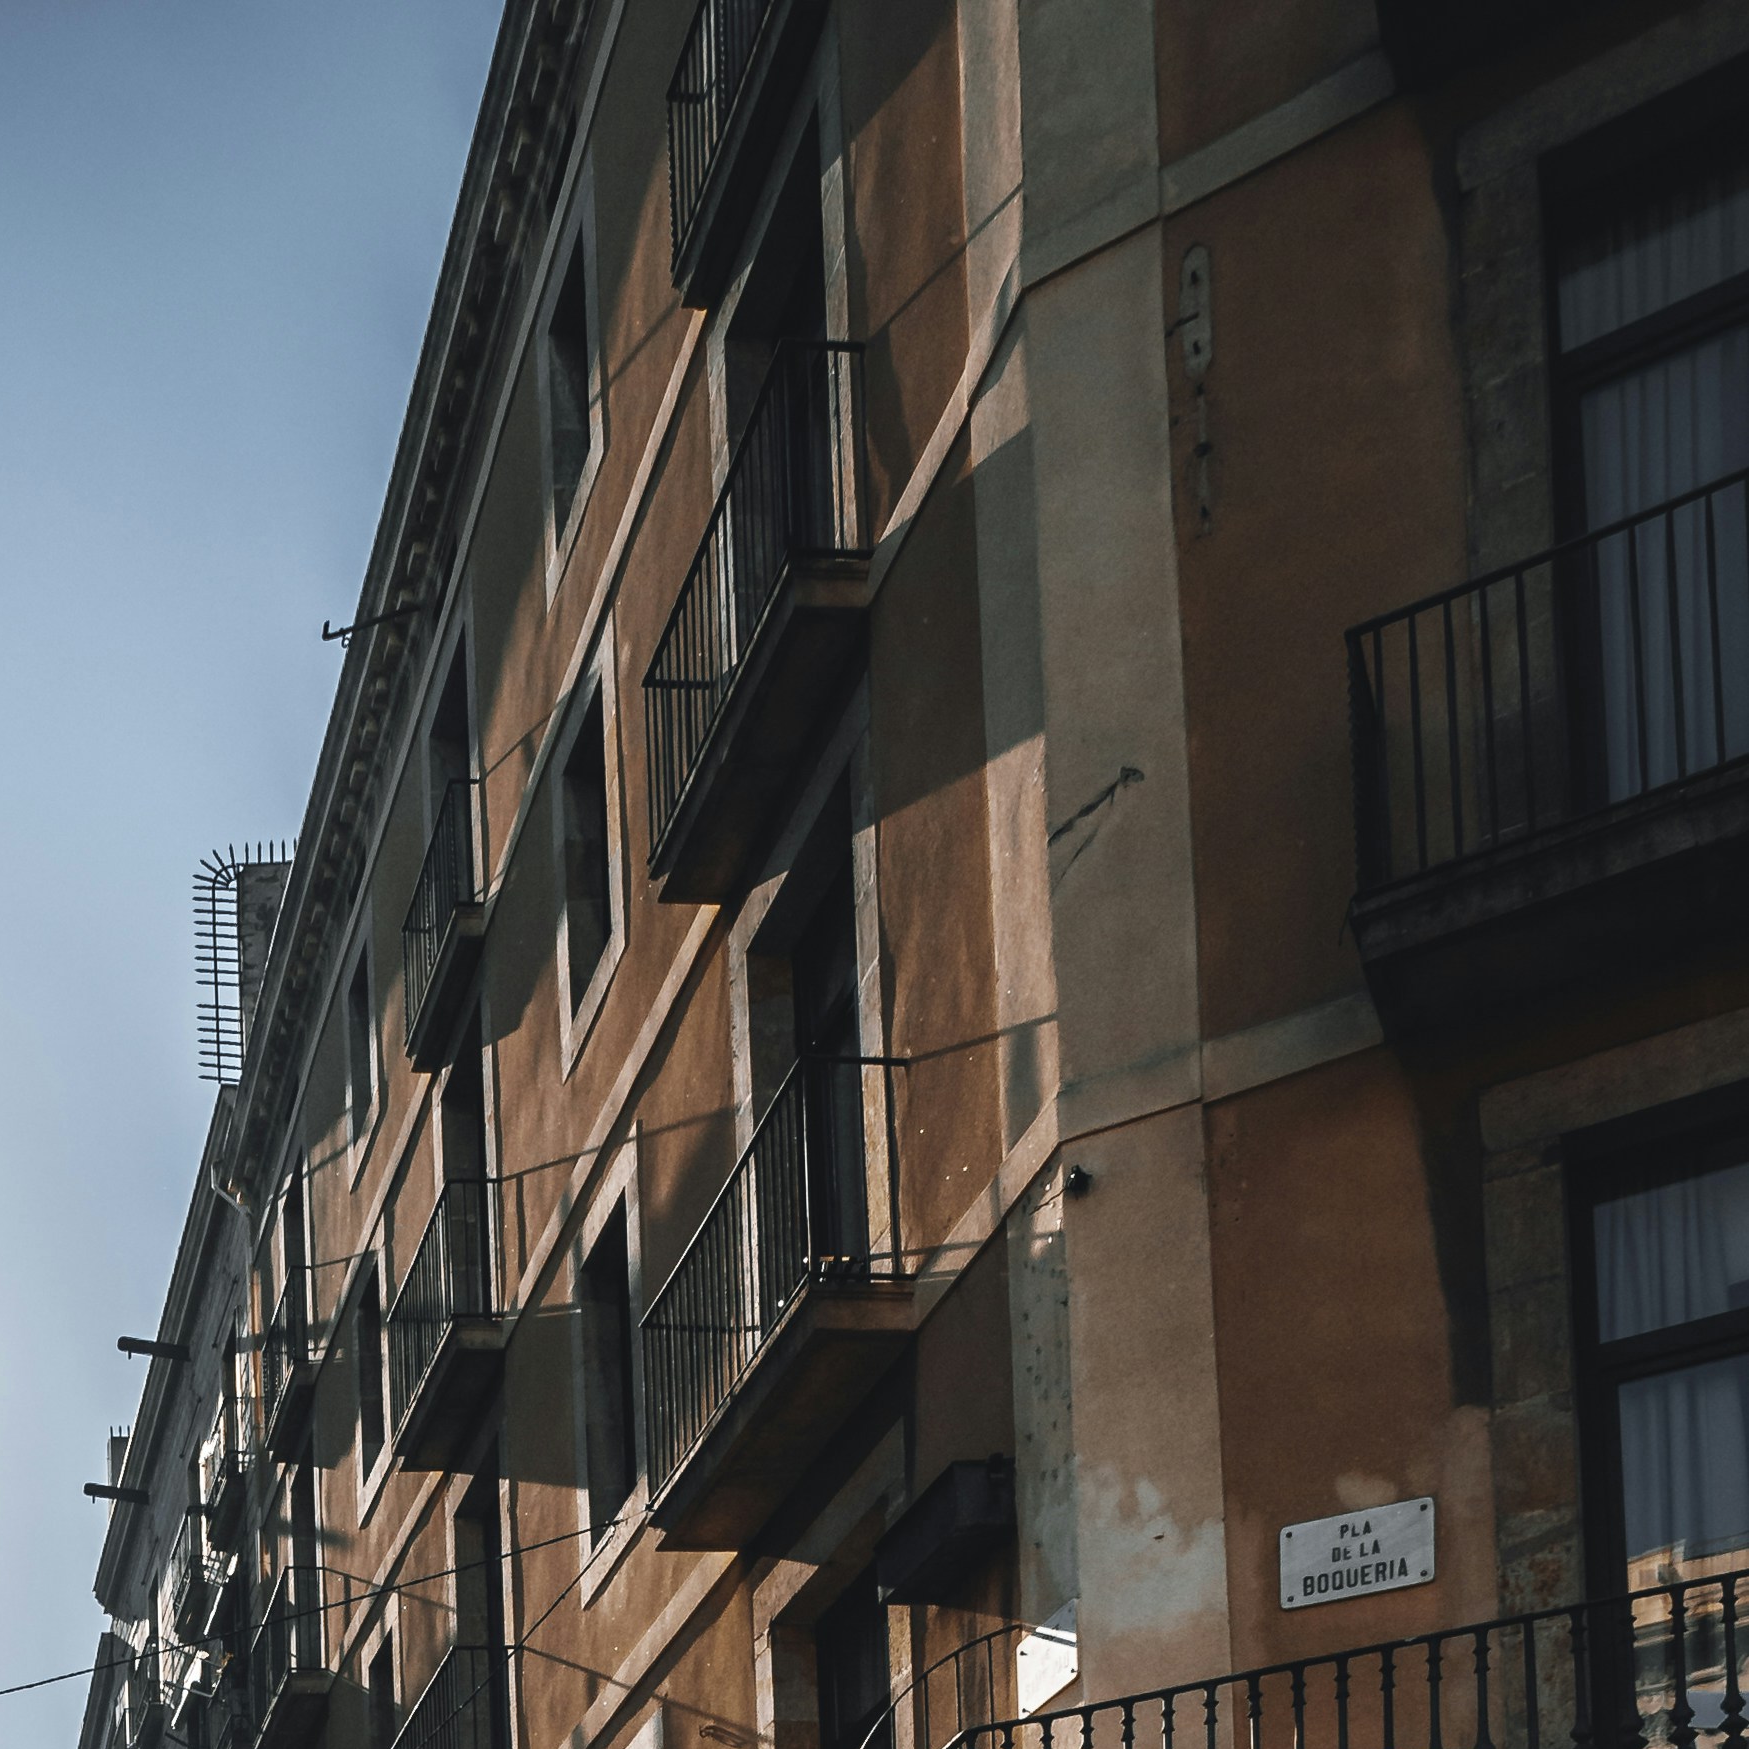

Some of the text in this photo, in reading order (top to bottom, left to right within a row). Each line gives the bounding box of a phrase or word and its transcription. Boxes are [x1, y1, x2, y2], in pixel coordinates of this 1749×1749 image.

[1339, 1520, 1372, 1539] PLA
[1331, 1539, 1381, 1563] DE LA
[1303, 1557, 1408, 1597] BOQUERIA
